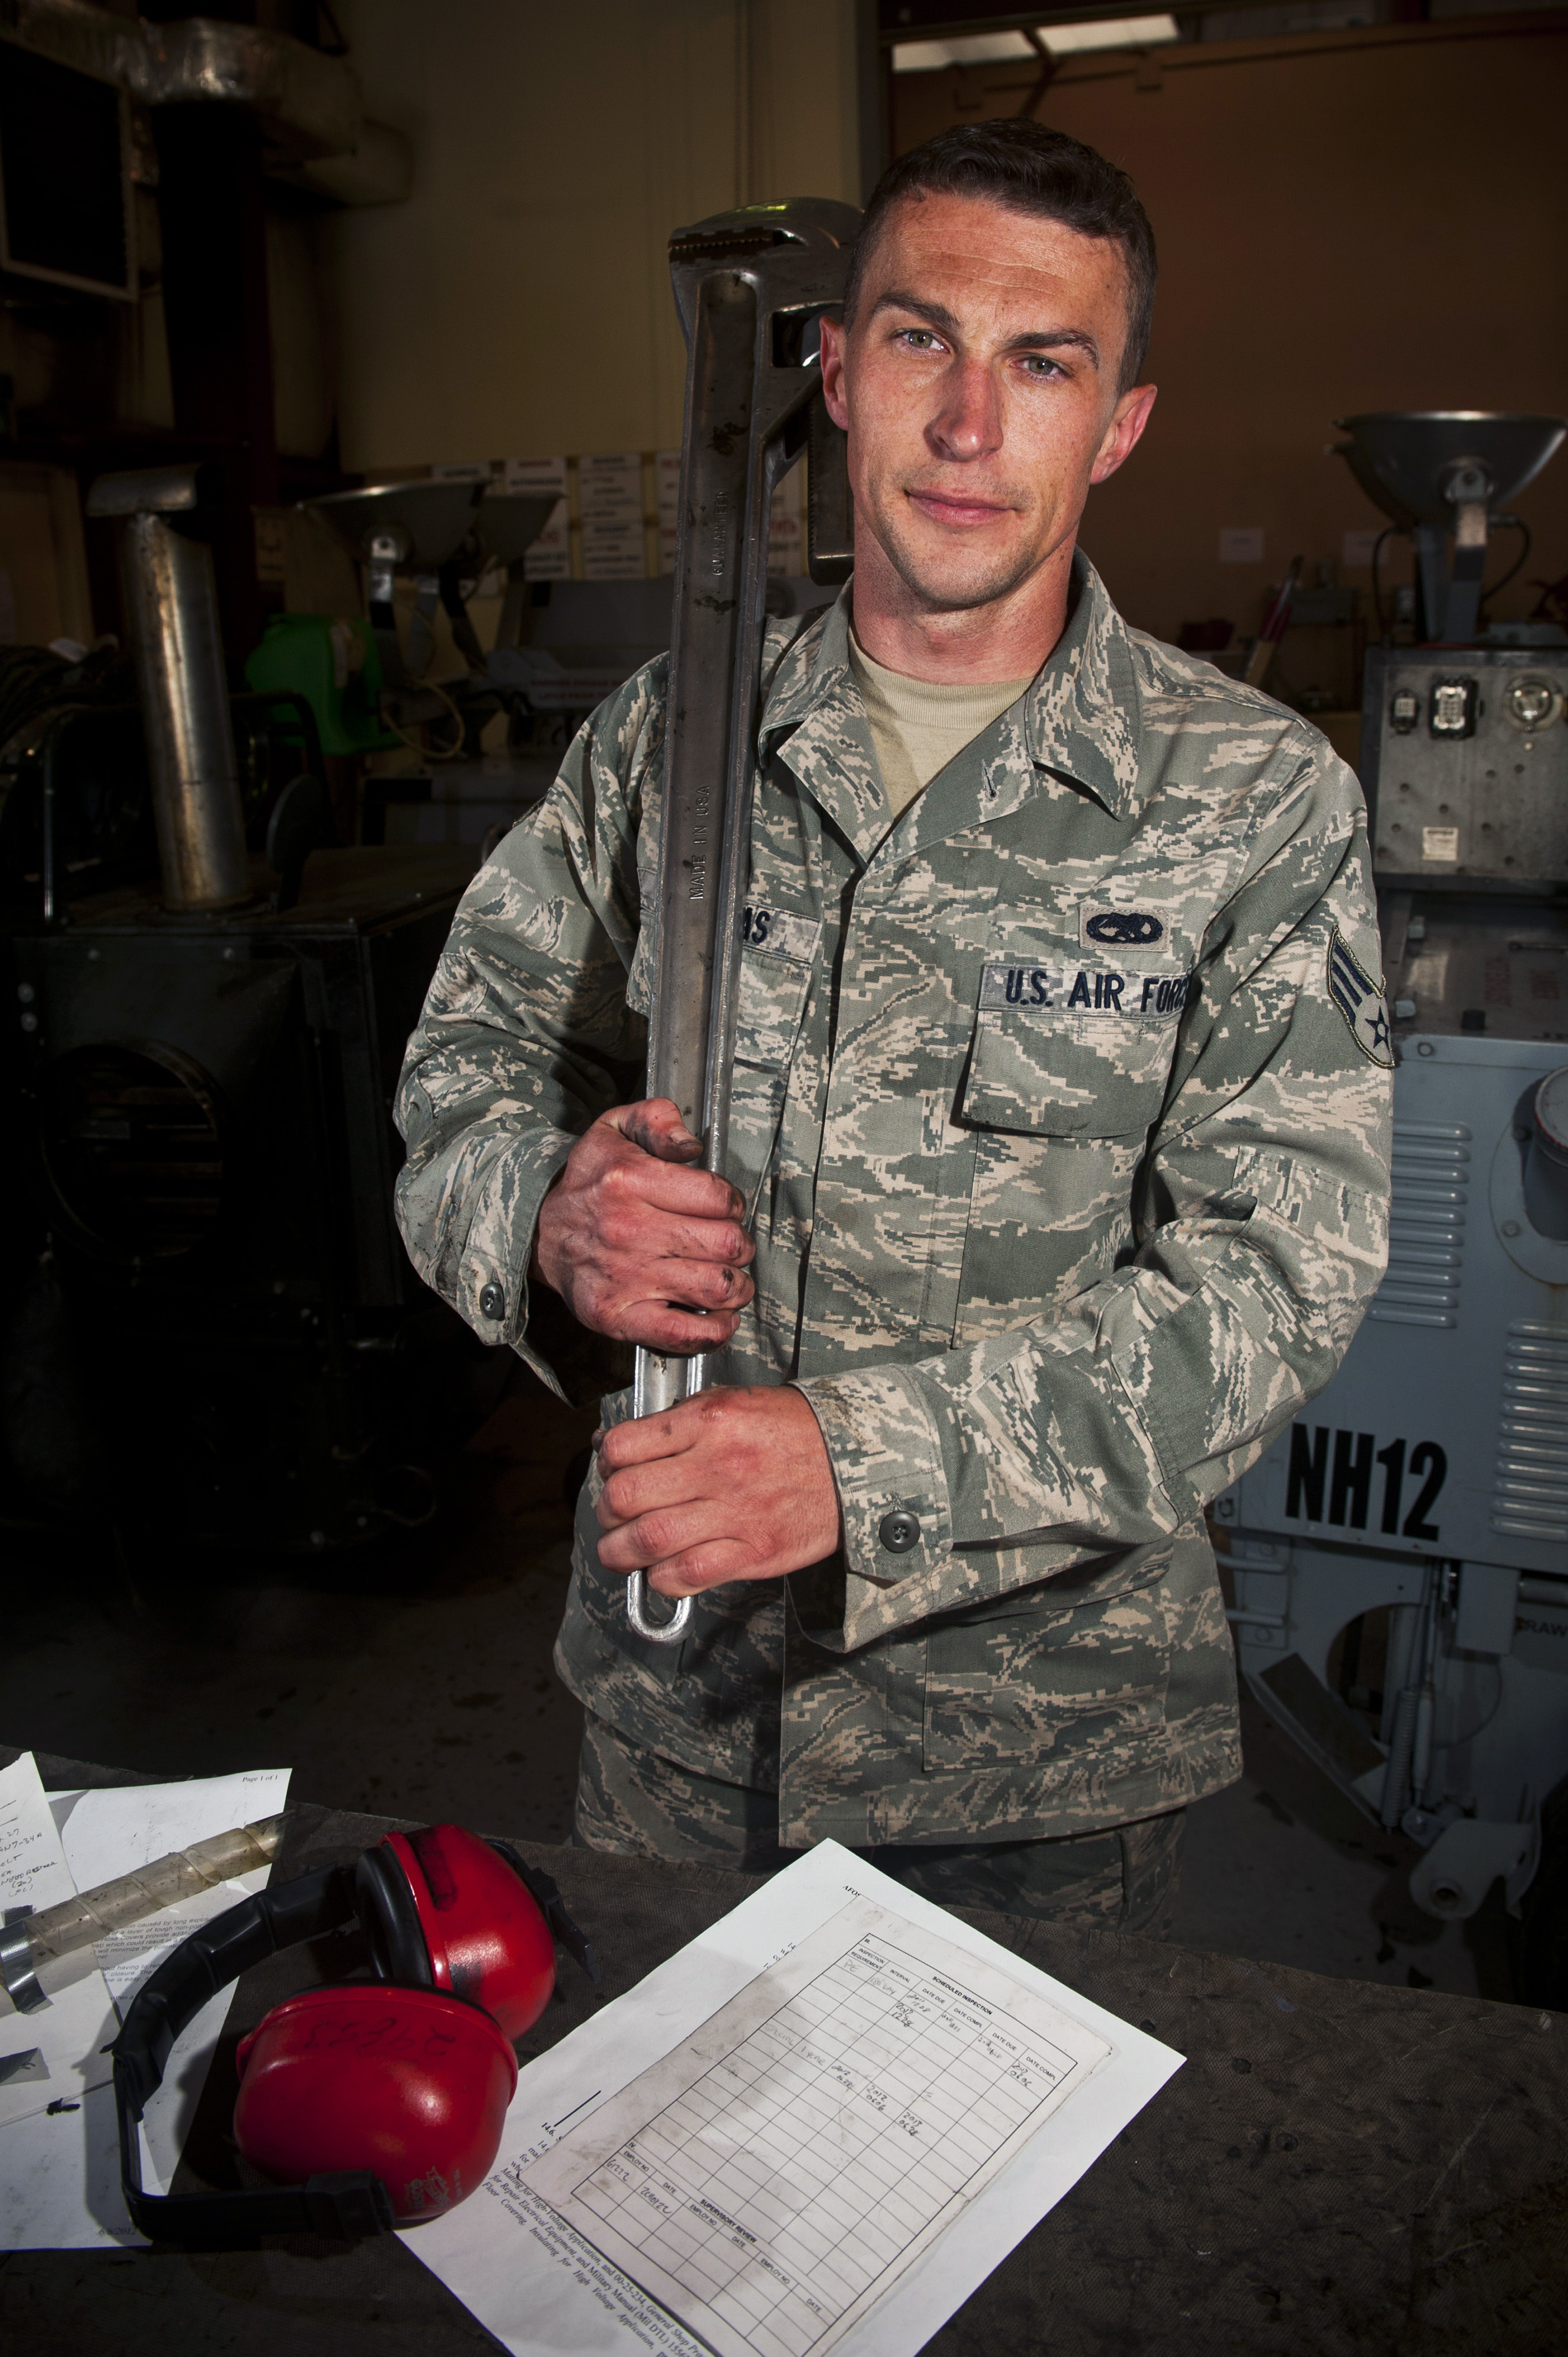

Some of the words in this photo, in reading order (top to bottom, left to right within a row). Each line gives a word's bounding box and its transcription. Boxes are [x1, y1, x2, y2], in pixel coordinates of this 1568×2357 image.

[711, 491, 728, 576] GUARANTEED
[695, 785, 711, 817] USA
[693, 825, 708, 845] IN
[688, 855, 706, 900] MADE
[1006, 969, 1054, 1008] U.S.
[1069, 971, 1124, 1011] AIR
[1140, 975, 1190, 1013] FORC
[1285, 1422, 1447, 1542] NH12
[0, 1853, 24, 1867] OLT
[851, 1951, 883, 1970] REQUIREMENT
[859, 1948, 885, 1964] INSPECTION
[889, 1969, 910, 1983] INTERVAL
[922, 1988, 935, 1999] DATE
[934, 1995, 946, 2005] DUE
[932, 1976, 962, 1996] SCHEDULED
[962, 1995, 993, 2015] INSPECTION
[953, 2008, 967, 2019] DATE
[966, 2015, 983, 2029] COMPL
[992, 2032, 1005, 2044] DATE
[1005, 2041, 1018, 2051] DUE
[1025, 2056, 1039, 2068] DATE
[1039, 2065, 1057, 2081] COMPL
[866, 2085, 887, 2102] 2012
[541, 2122, 556, 2137] 14.6.
[903, 2112, 923, 2127] 2013
[519, 2153, 530, 2164] for
[623, 2150, 643, 2167] EMPLOY
[641, 2164, 650, 2173] NO
[663, 2182, 677, 2195] DATE
[689, 2204, 709, 2221] EMPLOY
[707, 2217, 718, 2226] NO
[700, 2199, 737, 2228] SUPERVISORY
[735, 2225, 758, 2244] REVIEW
[731, 2236, 747, 2249] DATE
[482, 2181, 500, 2198] Floor
[529, 2227, 560, 2257] Insulating
[556, 2257, 572, 2268] for
[572, 2269, 591, 2287] High
[591, 2287, 616, 2312] Voltage
[617, 2313, 655, 2350] Application,
[488, 2174, 503, 2184] for
[500, 2183, 520, 2201] Repair
[518, 2199, 549, 2227] Electrical
[545, 2225, 578, 2258] Equipment,
[576, 2256, 591, 2269] and
[587, 2266, 613, 2292] Military
[611, 2288, 637, 2314] Manual
[633, 2311, 652, 2326] (Mil
[648, 2323, 669, 2345] DTL)
[500, 2167, 524, 2190] Matting
[520, 2187, 533, 2197] for
[530, 2195, 569, 2232] High-Voltage
[566, 2231, 602, 2266] Application,
[601, 2263, 616, 2276] and
[613, 2274, 647, 2308] 00-25-234,
[646, 2305, 674, 2330] General
[670, 2328, 690, 2346] Shop
[760, 2258, 782, 2277] EMPLOY
[781, 2275, 791, 2285] NO
[806, 2298, 823, 2314] DATE
